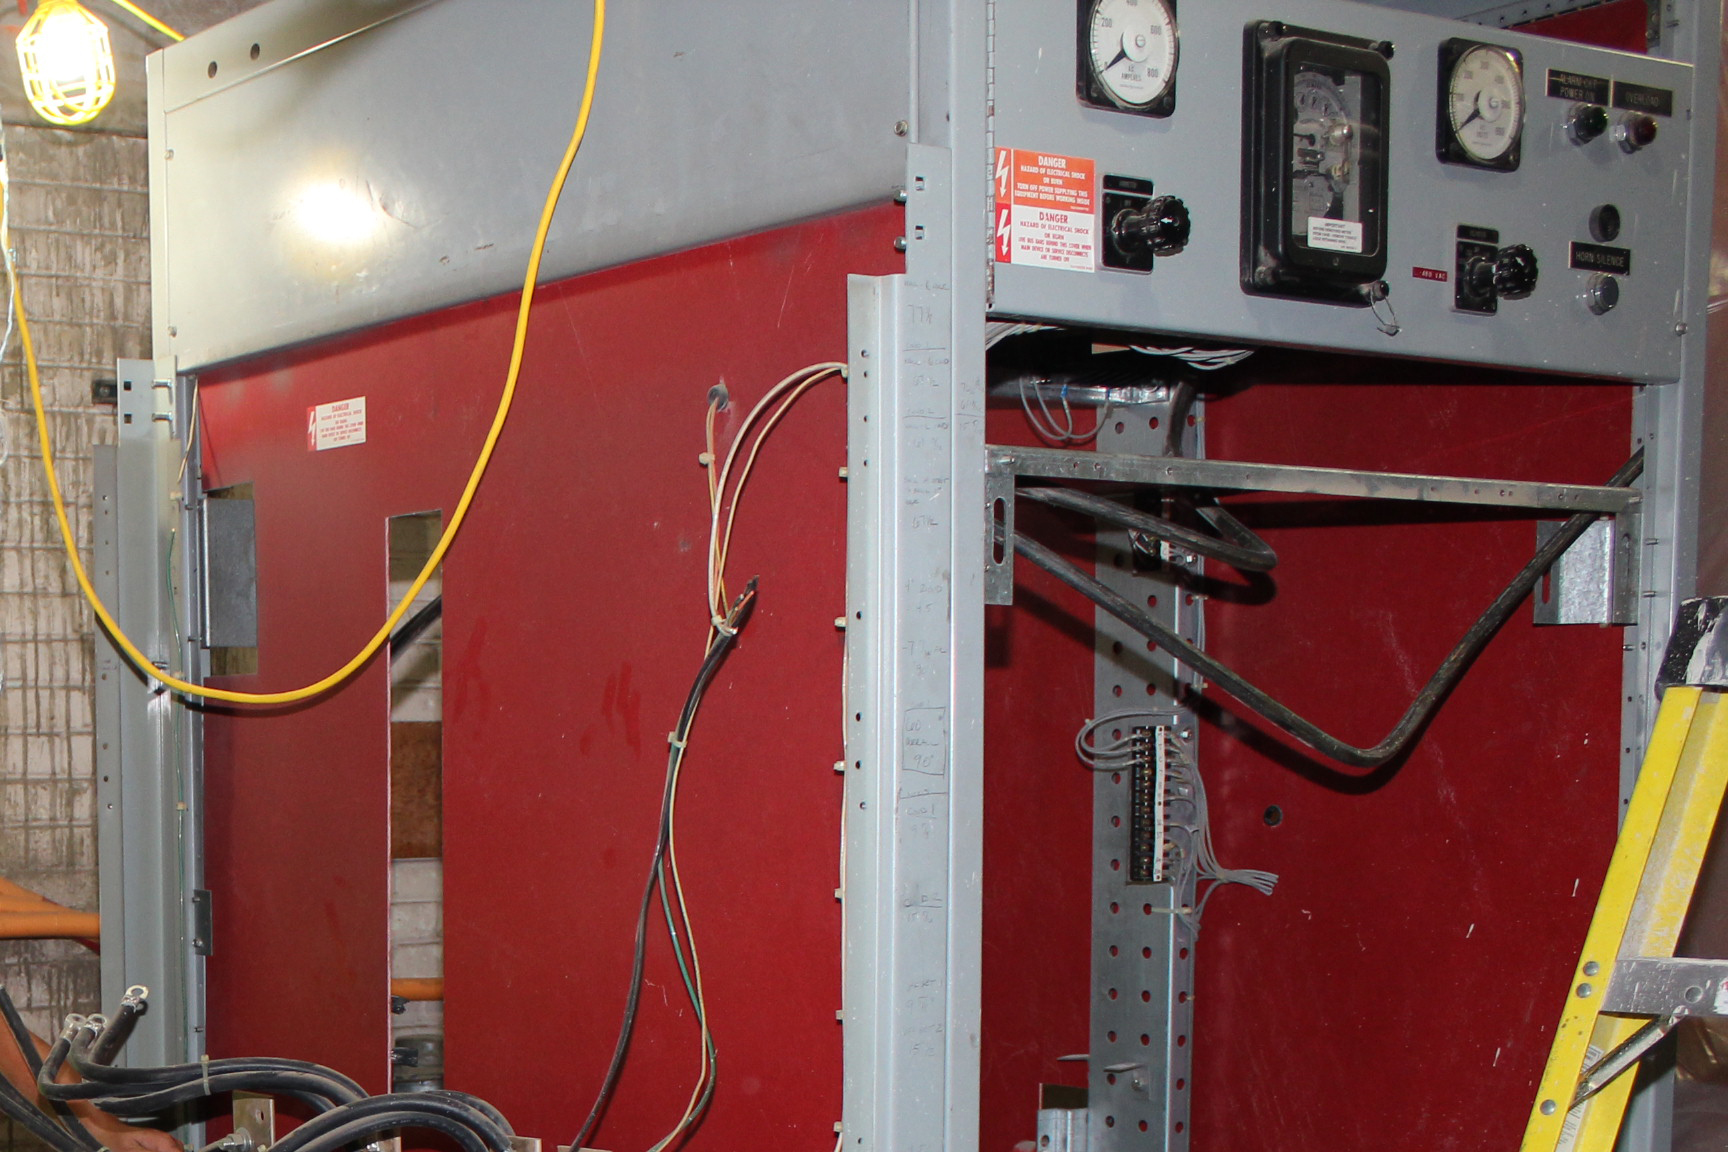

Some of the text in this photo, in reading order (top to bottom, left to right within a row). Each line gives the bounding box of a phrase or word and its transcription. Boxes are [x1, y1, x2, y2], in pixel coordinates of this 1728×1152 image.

[1559, 86, 1583, 98] POWER
[1038, 155, 1066, 168] DANGER
[1020, 165, 1039, 174] HAZARD
[1046, 168, 1070, 178] ELECTRICAL
[1039, 211, 1068, 224] DANGER
[1020, 221, 1039, 229] HAZARD
[1048, 224, 1072, 233] ELECTRICAL
[1074, 227, 1089, 235] SHOCK
[1575, 251, 1624, 268] HORN SILENCE
